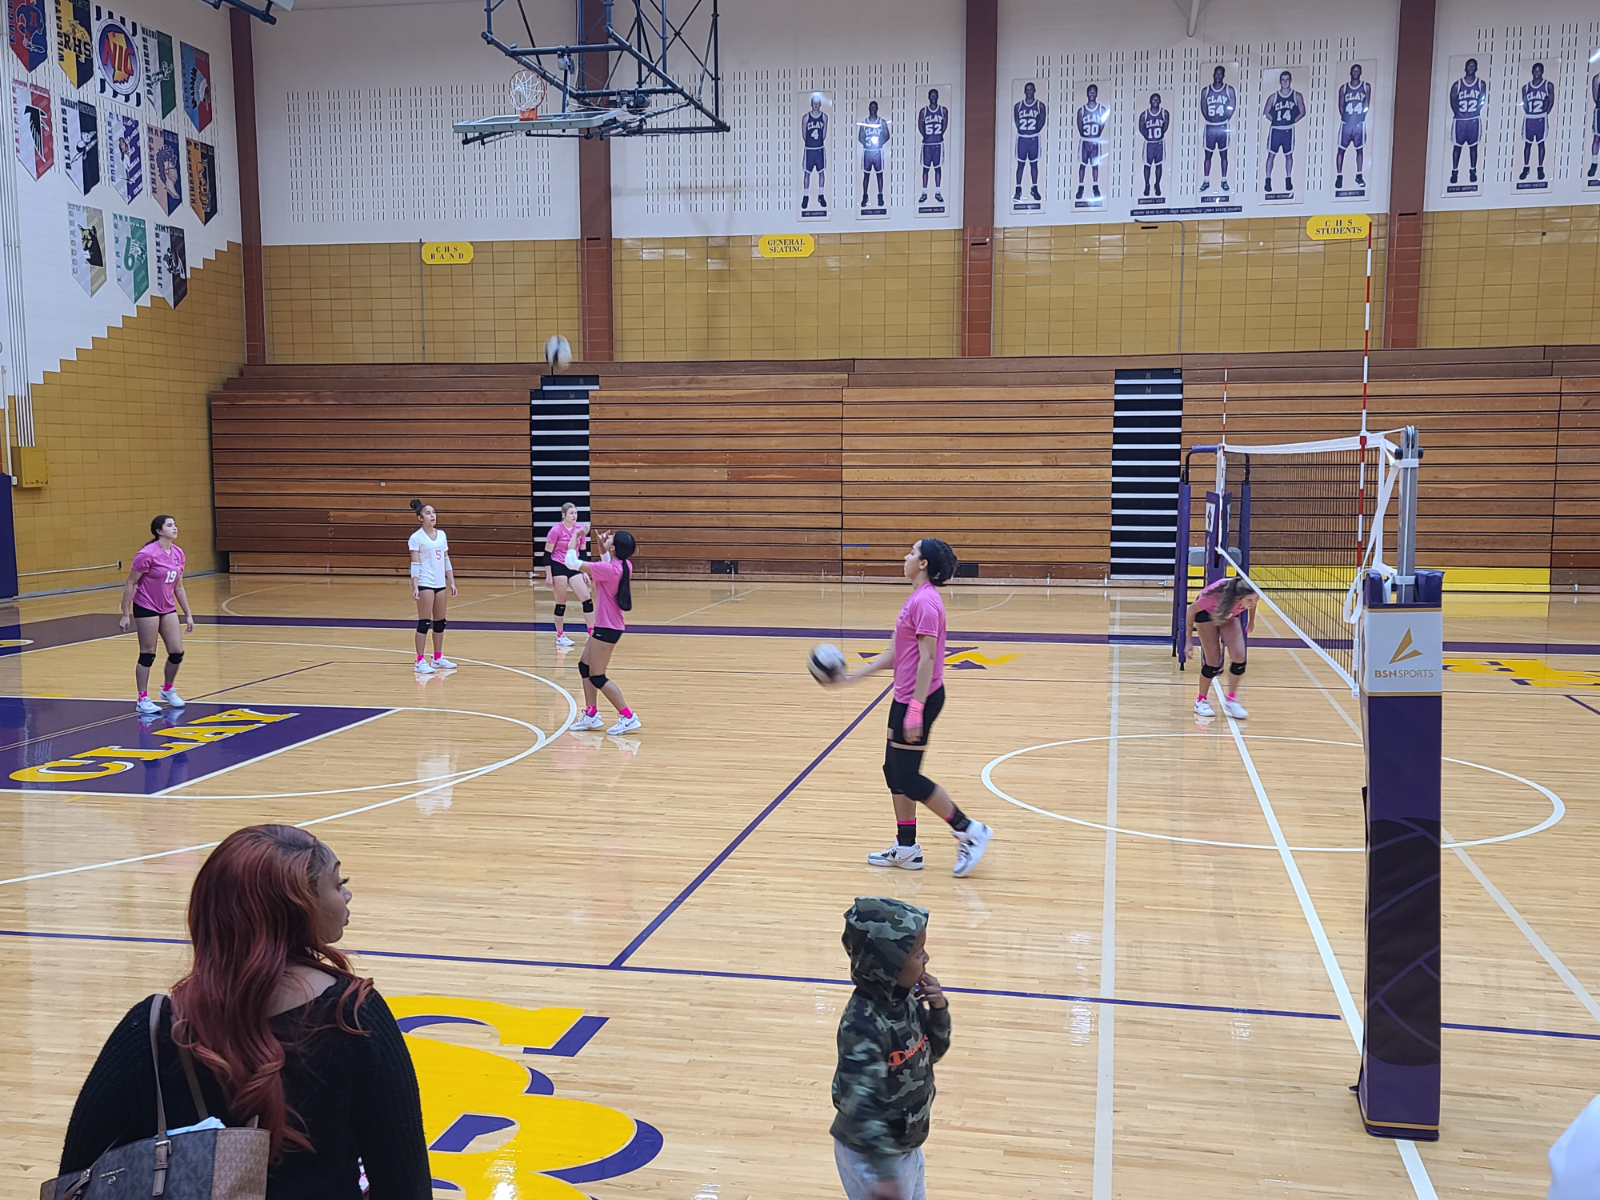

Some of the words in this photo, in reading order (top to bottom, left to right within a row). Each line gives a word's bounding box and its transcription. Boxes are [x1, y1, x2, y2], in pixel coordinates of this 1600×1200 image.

[55, 0, 65, 62] WILDCATS
[63, 32, 93, 60] RHS
[103, 38, 134, 77] NIC
[142, 36, 153, 96] PANTHERS
[1206, 95, 1228, 105] CLAY
[1345, 92, 1366, 102] CLAY
[1458, 90, 1480, 100] CLAY
[1526, 90, 1547, 100] CLAY
[1207, 105, 1225, 117] 54
[1274, 101, 1295, 110] CLAY
[1345, 102, 1363, 114] 44
[1458, 100, 1477, 112] 32
[1528, 100, 1543, 112] 12
[924, 115, 943, 124] CLAY
[1018, 110, 1039, 119] CLAY
[1276, 109, 1291, 121] 14
[807, 122, 824, 130] CLAY
[1019, 119, 1036, 130] 22
[1146, 119, 1164, 128] CLAY
[811, 129, 819, 139] 4
[925, 124, 942, 135] 52
[1083, 124, 1099, 135] 30
[1147, 128, 1162, 139] 10
[61, 108, 72, 170] BLAZERS
[148, 136, 157, 194] KNIGHTS
[1315, 226, 1363, 235] STUDENTS
[767, 238, 805, 246] GENERAL
[435, 550, 441, 560] 5
[165, 571, 177, 584] 19
[1374, 669, 1397, 678] BSN
[1398, 669, 1434, 678] SPORTS
[9, 708, 301, 783] CLAY
